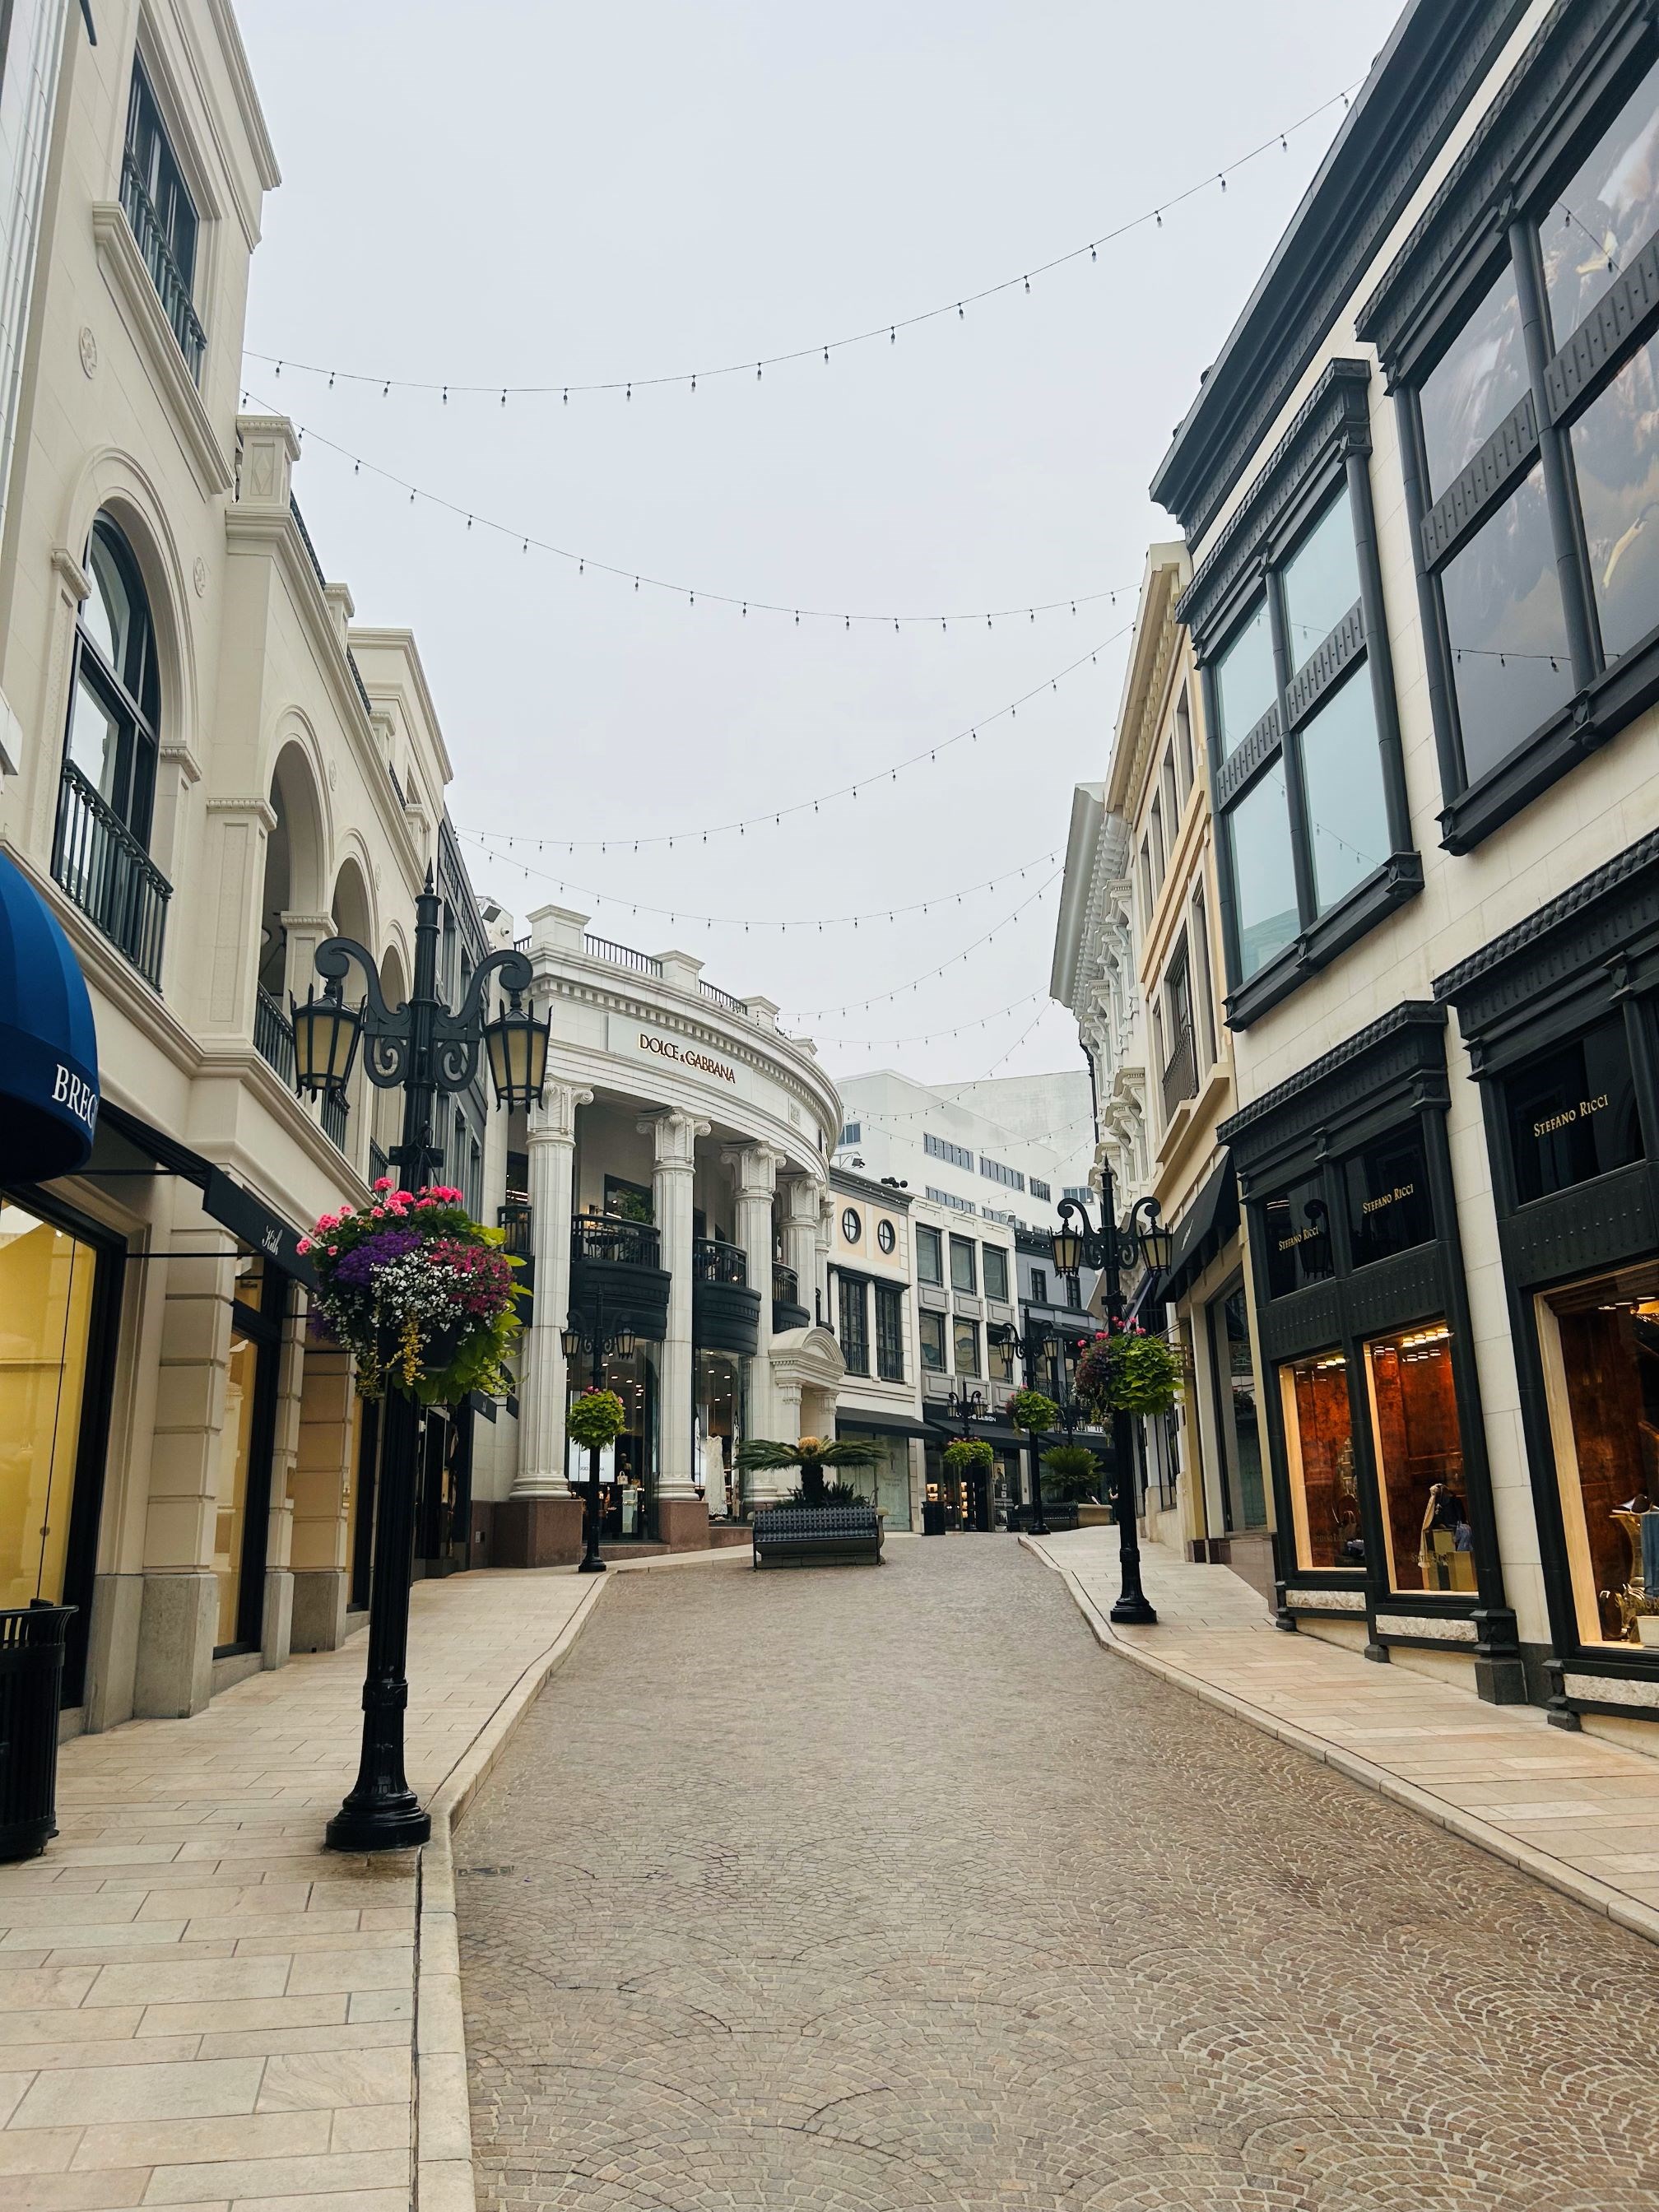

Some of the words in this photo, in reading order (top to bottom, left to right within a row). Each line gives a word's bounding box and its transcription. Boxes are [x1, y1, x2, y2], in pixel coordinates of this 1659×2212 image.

[639, 1034, 679, 1061] DOLCE
[685, 1050, 737, 1084] GABBANA
[1534, 1109, 1577, 1137] STEFANO
[1579, 1094, 1609, 1117] RICCI
[1363, 1193, 1392, 1214] STEFANO
[1394, 1183, 1415, 1201] RICCI
[1278, 1234, 1302, 1252] STEFANO
[1303, 1225, 1319, 1241] RICCI
[1087, 1425, 1104, 1434] MILLE
